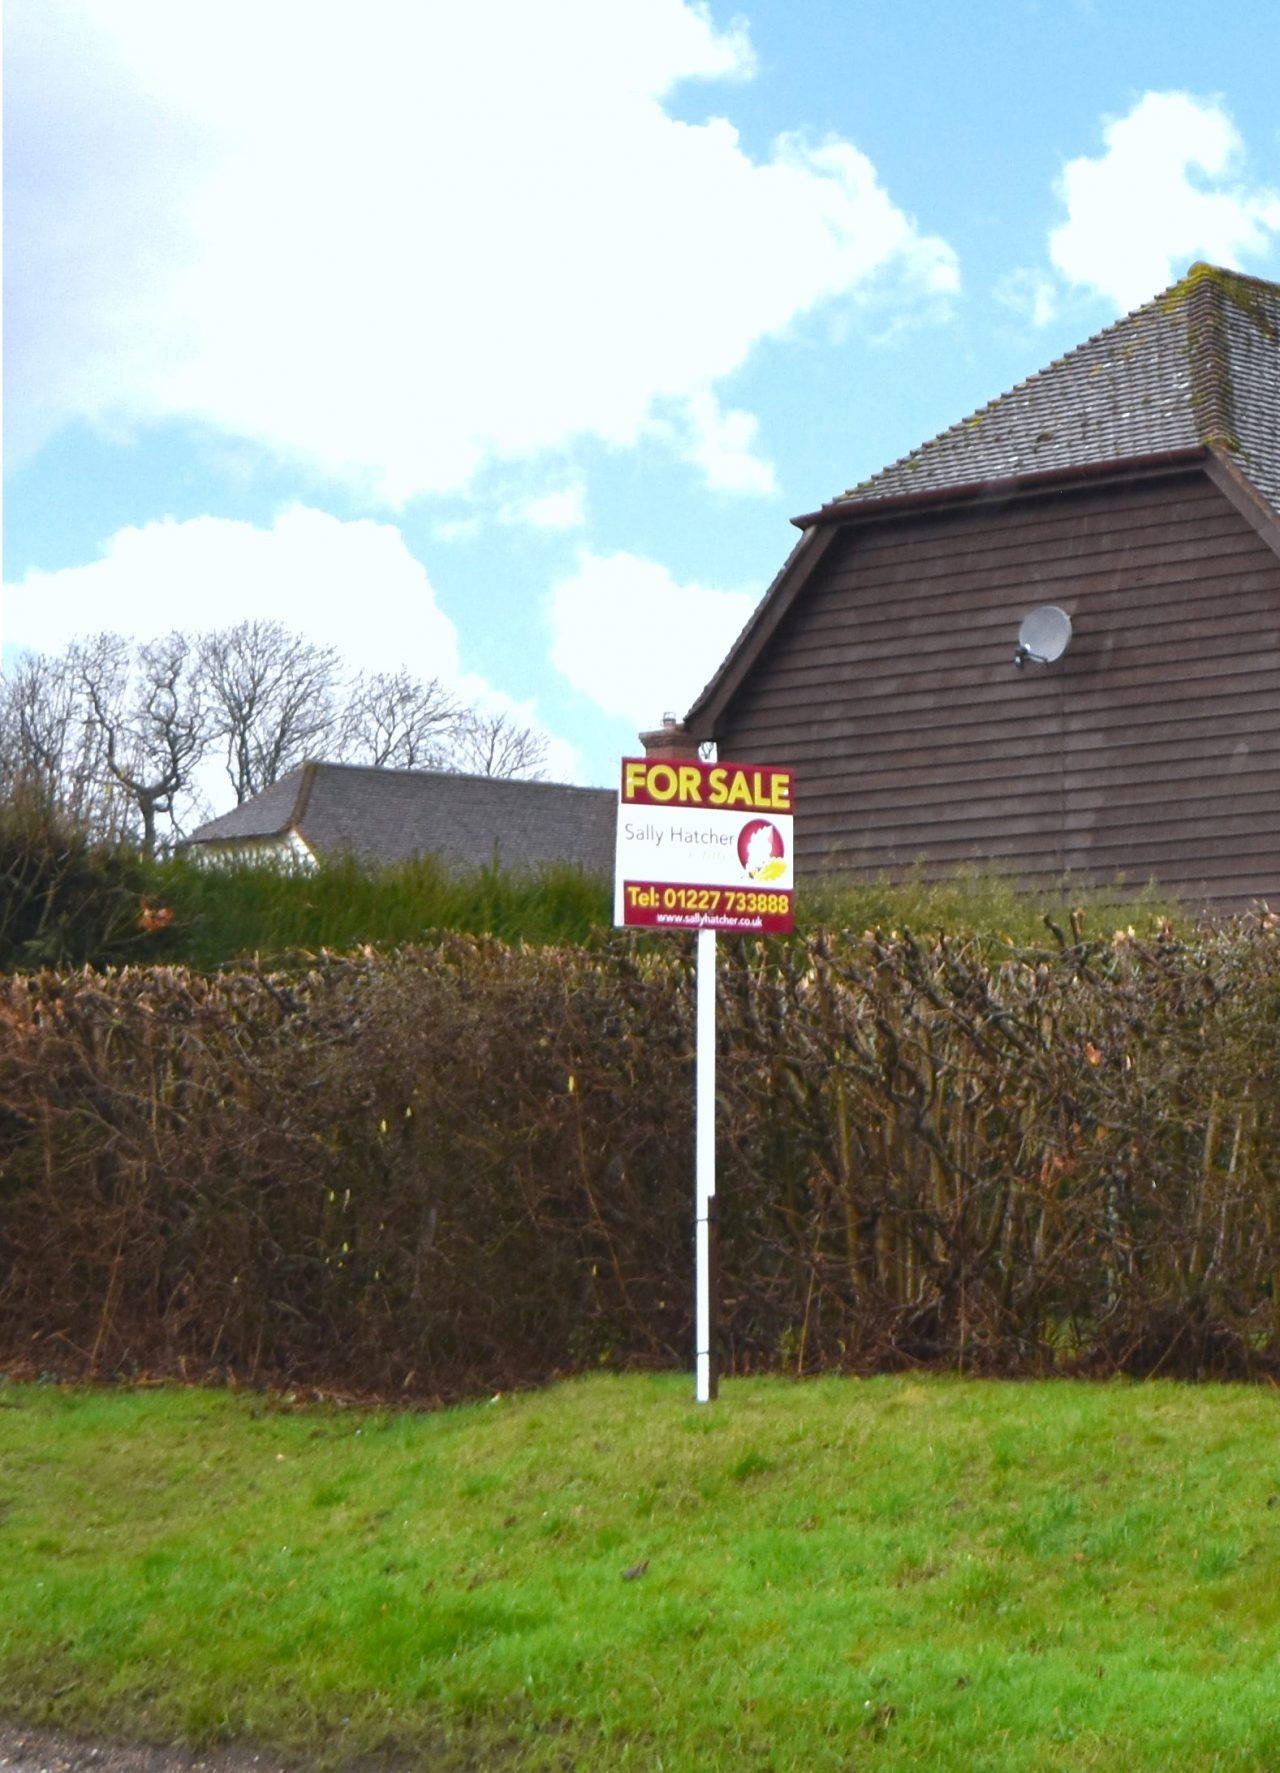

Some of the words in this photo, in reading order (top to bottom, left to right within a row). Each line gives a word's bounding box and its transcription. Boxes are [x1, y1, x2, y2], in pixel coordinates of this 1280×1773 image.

[626, 764, 702, 802] FOR
[709, 768, 790, 808] SALE
[625, 823, 664, 846] Sally
[670, 827, 735, 845] Hatcher
[627, 887, 660, 907] Tel:
[664, 888, 720, 910] 01227
[725, 892, 789, 914] 733888
[657, 913, 763, 928] www.sallyhatcher.co.uk
